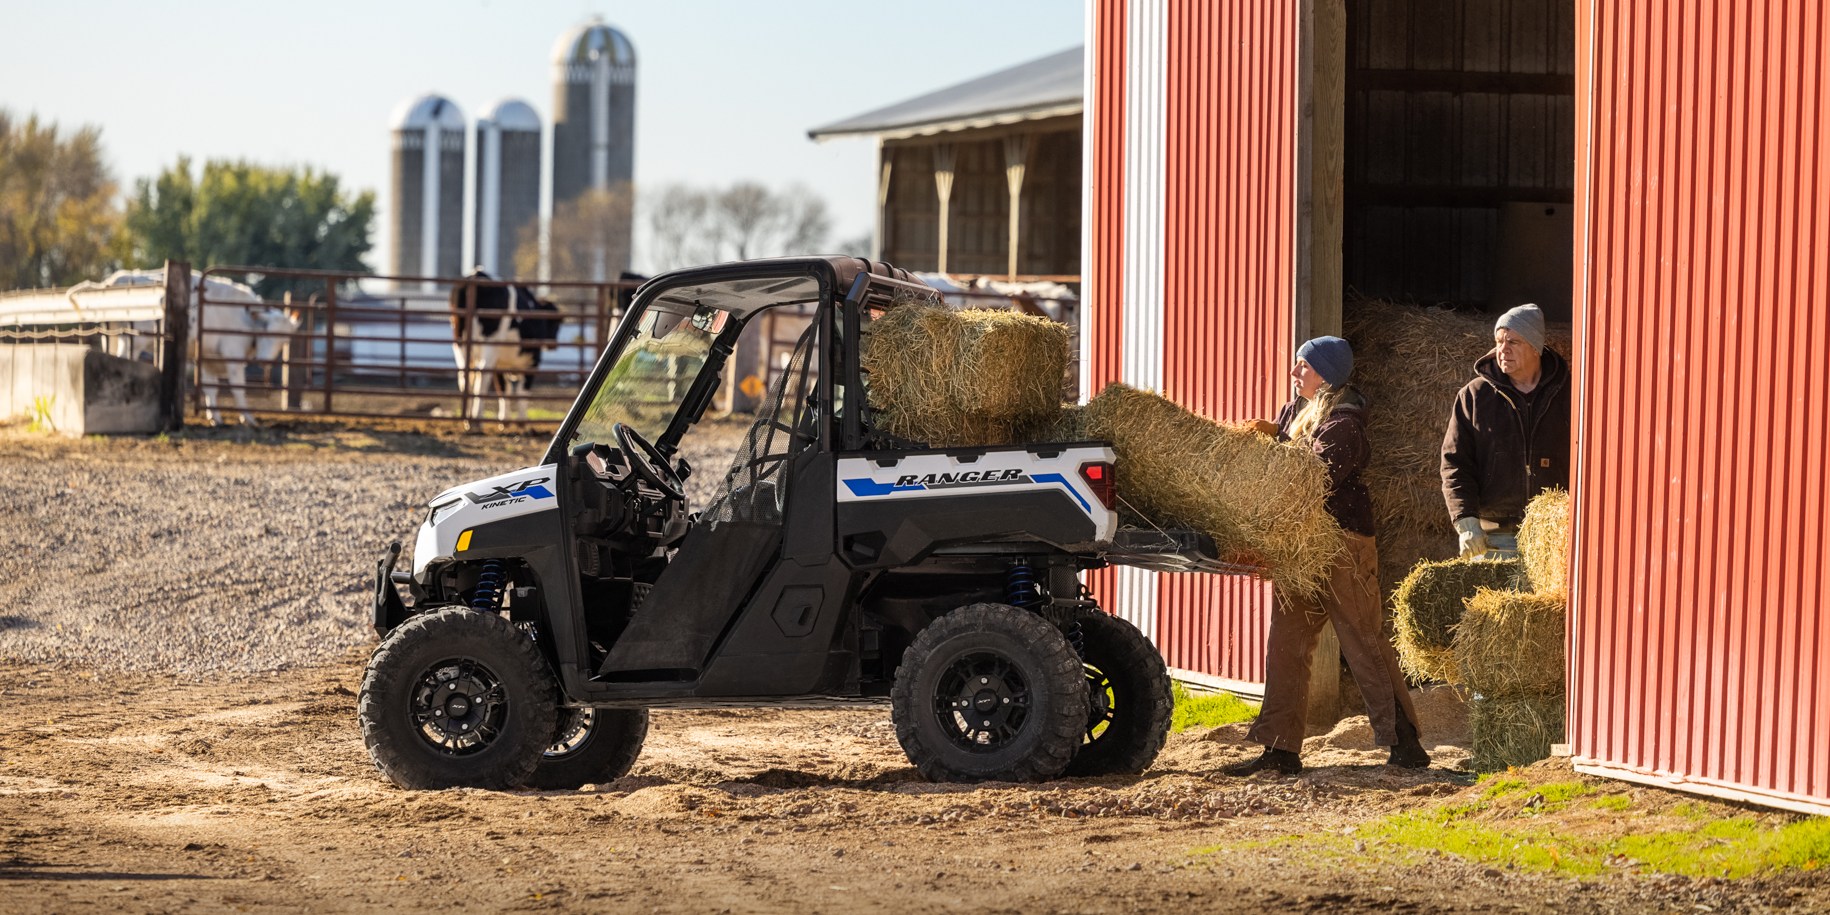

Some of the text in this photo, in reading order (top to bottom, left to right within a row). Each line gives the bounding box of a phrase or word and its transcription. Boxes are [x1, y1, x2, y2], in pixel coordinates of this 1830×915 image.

[894, 469, 1023, 487] RANGER
[479, 477, 551, 501] XP
[481, 496, 527, 510] KINETIC
